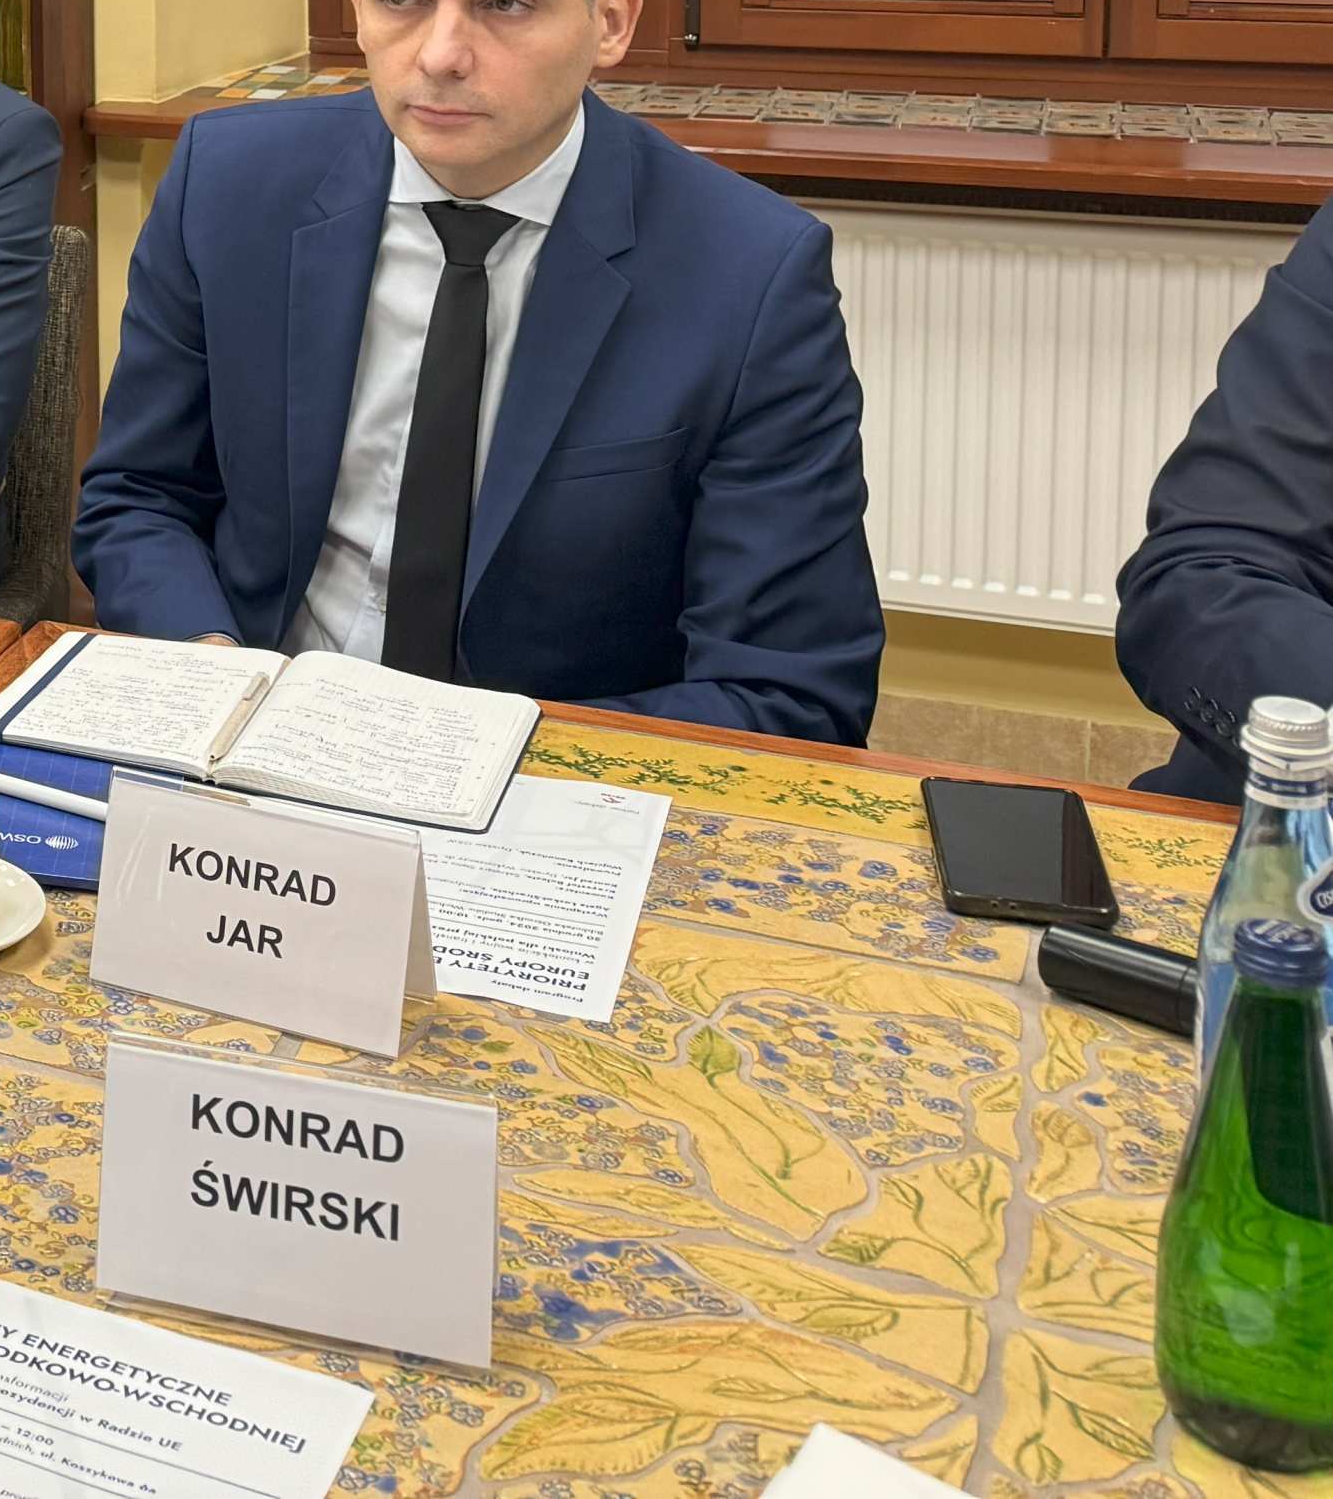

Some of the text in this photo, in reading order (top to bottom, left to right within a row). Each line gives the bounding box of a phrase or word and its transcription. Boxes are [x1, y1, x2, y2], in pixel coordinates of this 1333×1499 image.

[168, 843, 337, 908] KONRAD
[206, 914, 284, 960] JAR
[449, 960, 588, 992] PRIORYTETY
[500, 957, 591, 980] EUROPY
[191, 1093, 405, 1165] KONRAD
[190, 1160, 402, 1243] ŚWIRSKI
[22, 1333, 233, 1407] ENERGETYCZNE
[15, 1426, 55, 1448] 12:00
[98, 1418, 154, 1444] Radzie
[157, 1436, 184, 1452] UE
